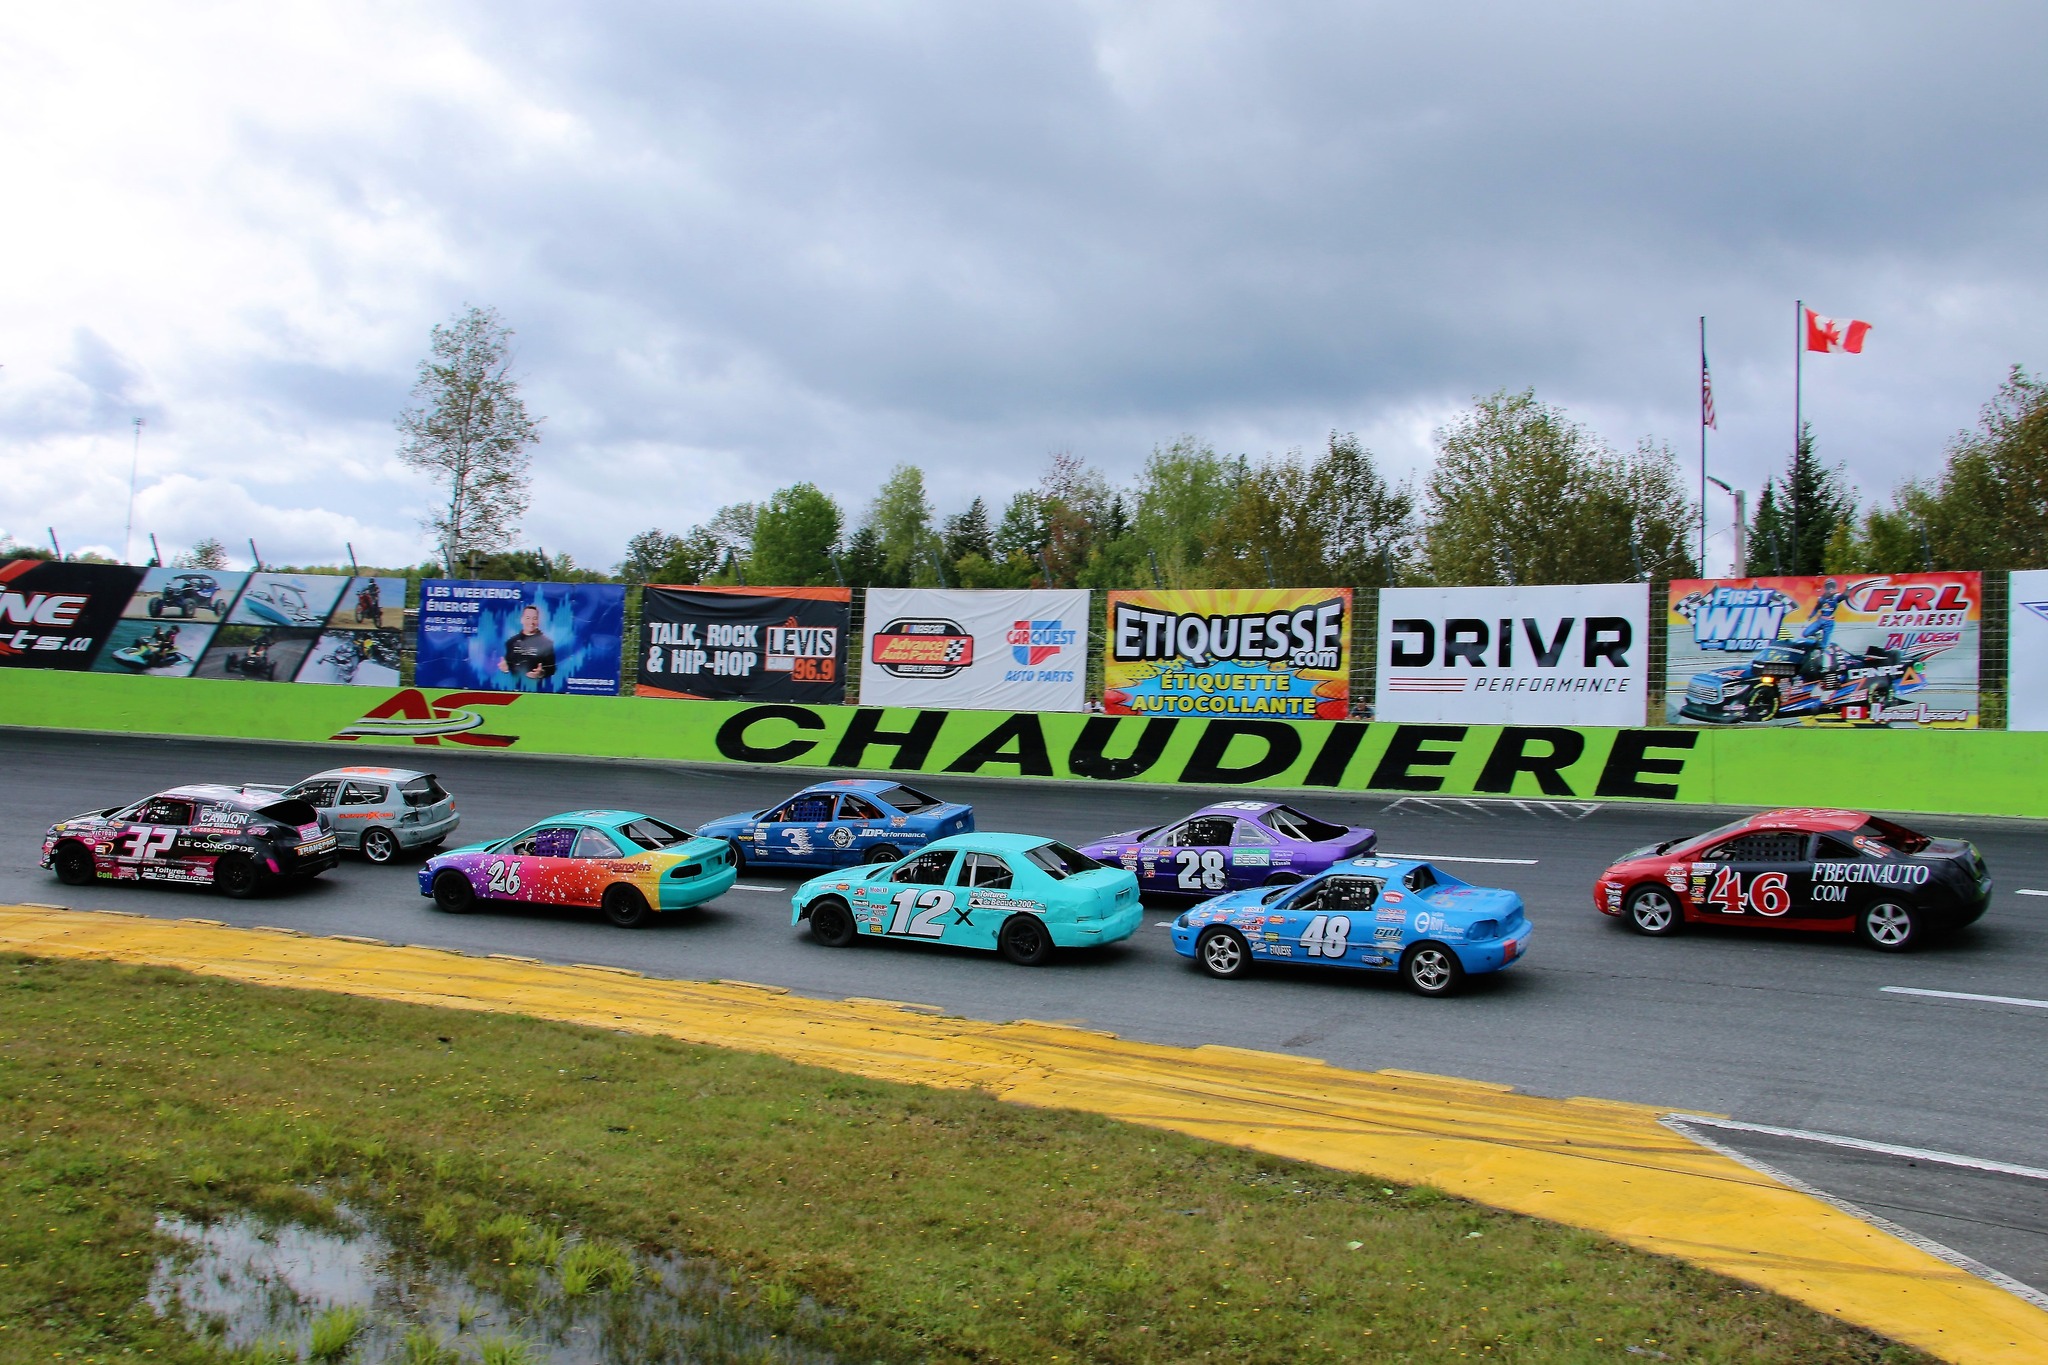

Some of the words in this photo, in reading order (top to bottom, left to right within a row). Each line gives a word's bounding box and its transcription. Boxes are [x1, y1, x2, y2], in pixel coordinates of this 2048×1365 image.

[427, 586, 450, 597] LES
[453, 588, 521, 599] WEEKENDS
[1712, 588, 1771, 605] FIRST
[1863, 586, 1967, 612] FRL
[426, 599, 479, 612] ÉNERGIE
[1694, 606, 1784, 640] WIN
[1878, 612, 1962, 626] EXPRESS!
[649, 622, 701, 650] TALK,
[706, 624, 759, 647] ROCK
[913, 625, 946, 634] NASCAR
[1006, 630, 1077, 646] CARQUEST
[1116, 603, 1341, 664] ETIQUESSE
[770, 628, 834, 657] LEVIS
[885, 638, 944, 650] Advance
[1390, 616, 1632, 668] DRIVR
[646, 645, 663, 673] &
[670, 650, 758, 677] HIP-HOP
[878, 649, 908, 660] Auto
[908, 650, 942, 661] Parts
[1289, 650, 1337, 667] .com
[793, 658, 834, 681] 96.9
[1004, 670, 1034, 682] AUTO
[1036, 670, 1074, 683] PARTS
[1847, 664, 1904, 680] CANAC
[1161, 669, 1290, 693] ÉTIQUETTE
[1474, 677, 1631, 693] PERFORMANCE
[1131, 695, 1317, 714] AUTOCOLLANTE
[715, 704, 1700, 800] CHAUDIERE
[201, 811, 249, 825] CAMION
[177, 840, 191, 848] LE
[193, 842, 256, 854] CONCORDE
[781, 828, 814, 856] 3
[154, 866, 187, 875] Toitures
[167, 872, 205, 882] Beauce
[486, 859, 522, 896] 26
[1176, 849, 1226, 890] 28
[1811, 862, 1930, 885] FBEGINAUTO
[980, 890, 1008, 899] Toitures
[1708, 865, 1790, 917] 46
[1811, 885, 1848, 903] .COM
[991, 897, 1017, 907] Beauce
[888, 888, 956, 939] 12
[953, 907, 974, 927] X
[1299, 914, 1351, 958] 48
